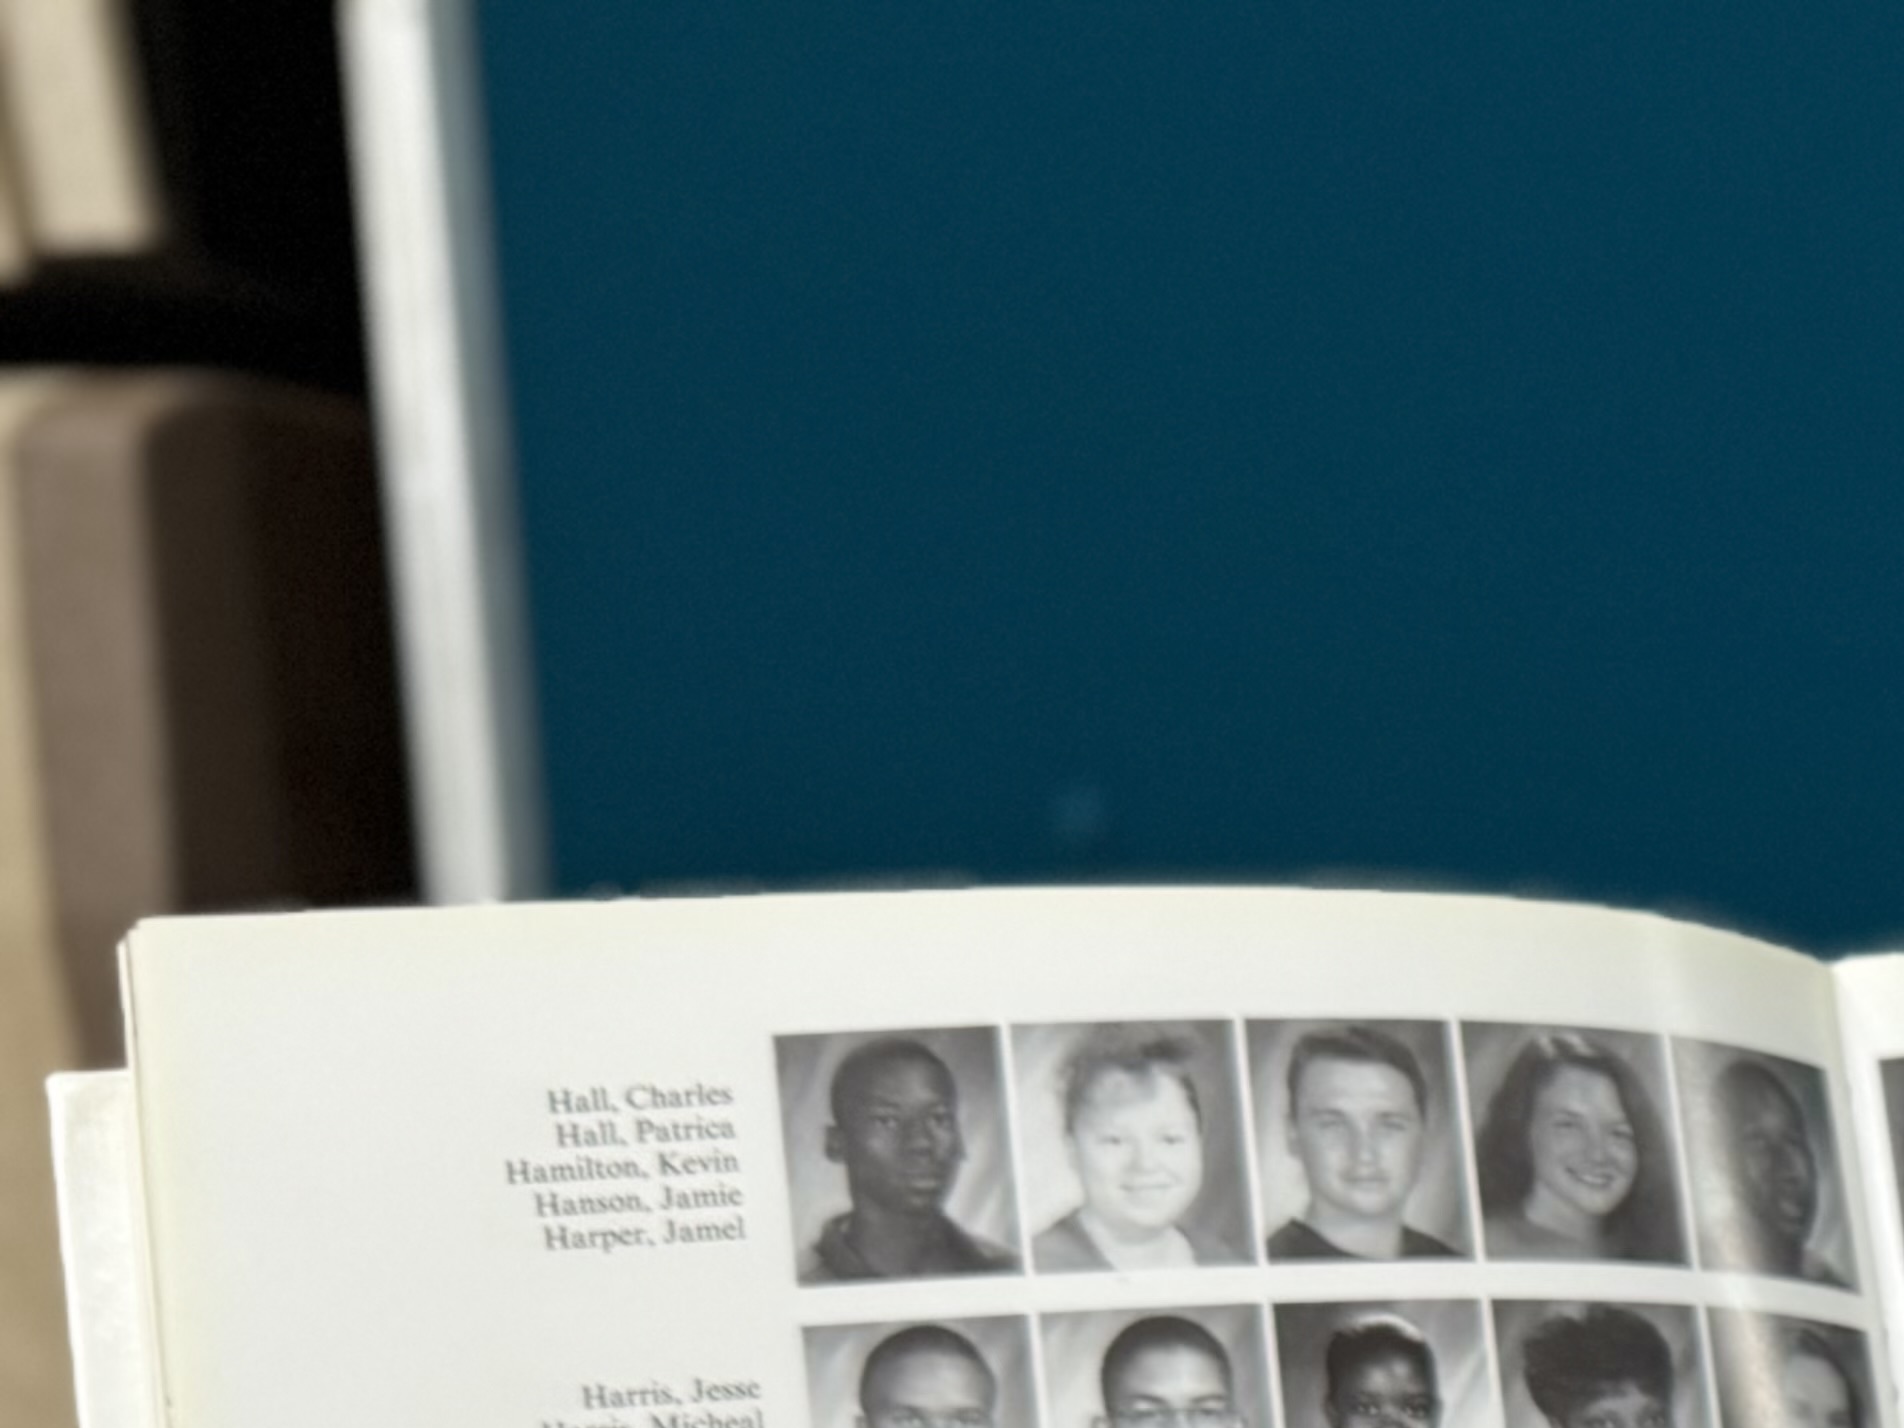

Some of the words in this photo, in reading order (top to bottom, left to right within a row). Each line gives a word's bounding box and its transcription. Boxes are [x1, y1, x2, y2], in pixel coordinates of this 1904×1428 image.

[548, 1086, 620, 1114] Hall,
[625, 1082, 734, 1110] Charles
[556, 1120, 628, 1147] Hall,
[636, 1116, 735, 1144] Patrica
[505, 1154, 649, 1184] Hamilton,
[657, 1148, 740, 1176] Kevin
[535, 1191, 653, 1217] Hanson,
[659, 1182, 744, 1210] Jamie
[544, 1224, 656, 1253] Harper,
[663, 1215, 747, 1244] Jamel
[582, 1380, 682, 1410] Harris,
[690, 1378, 762, 1403] Jesse
